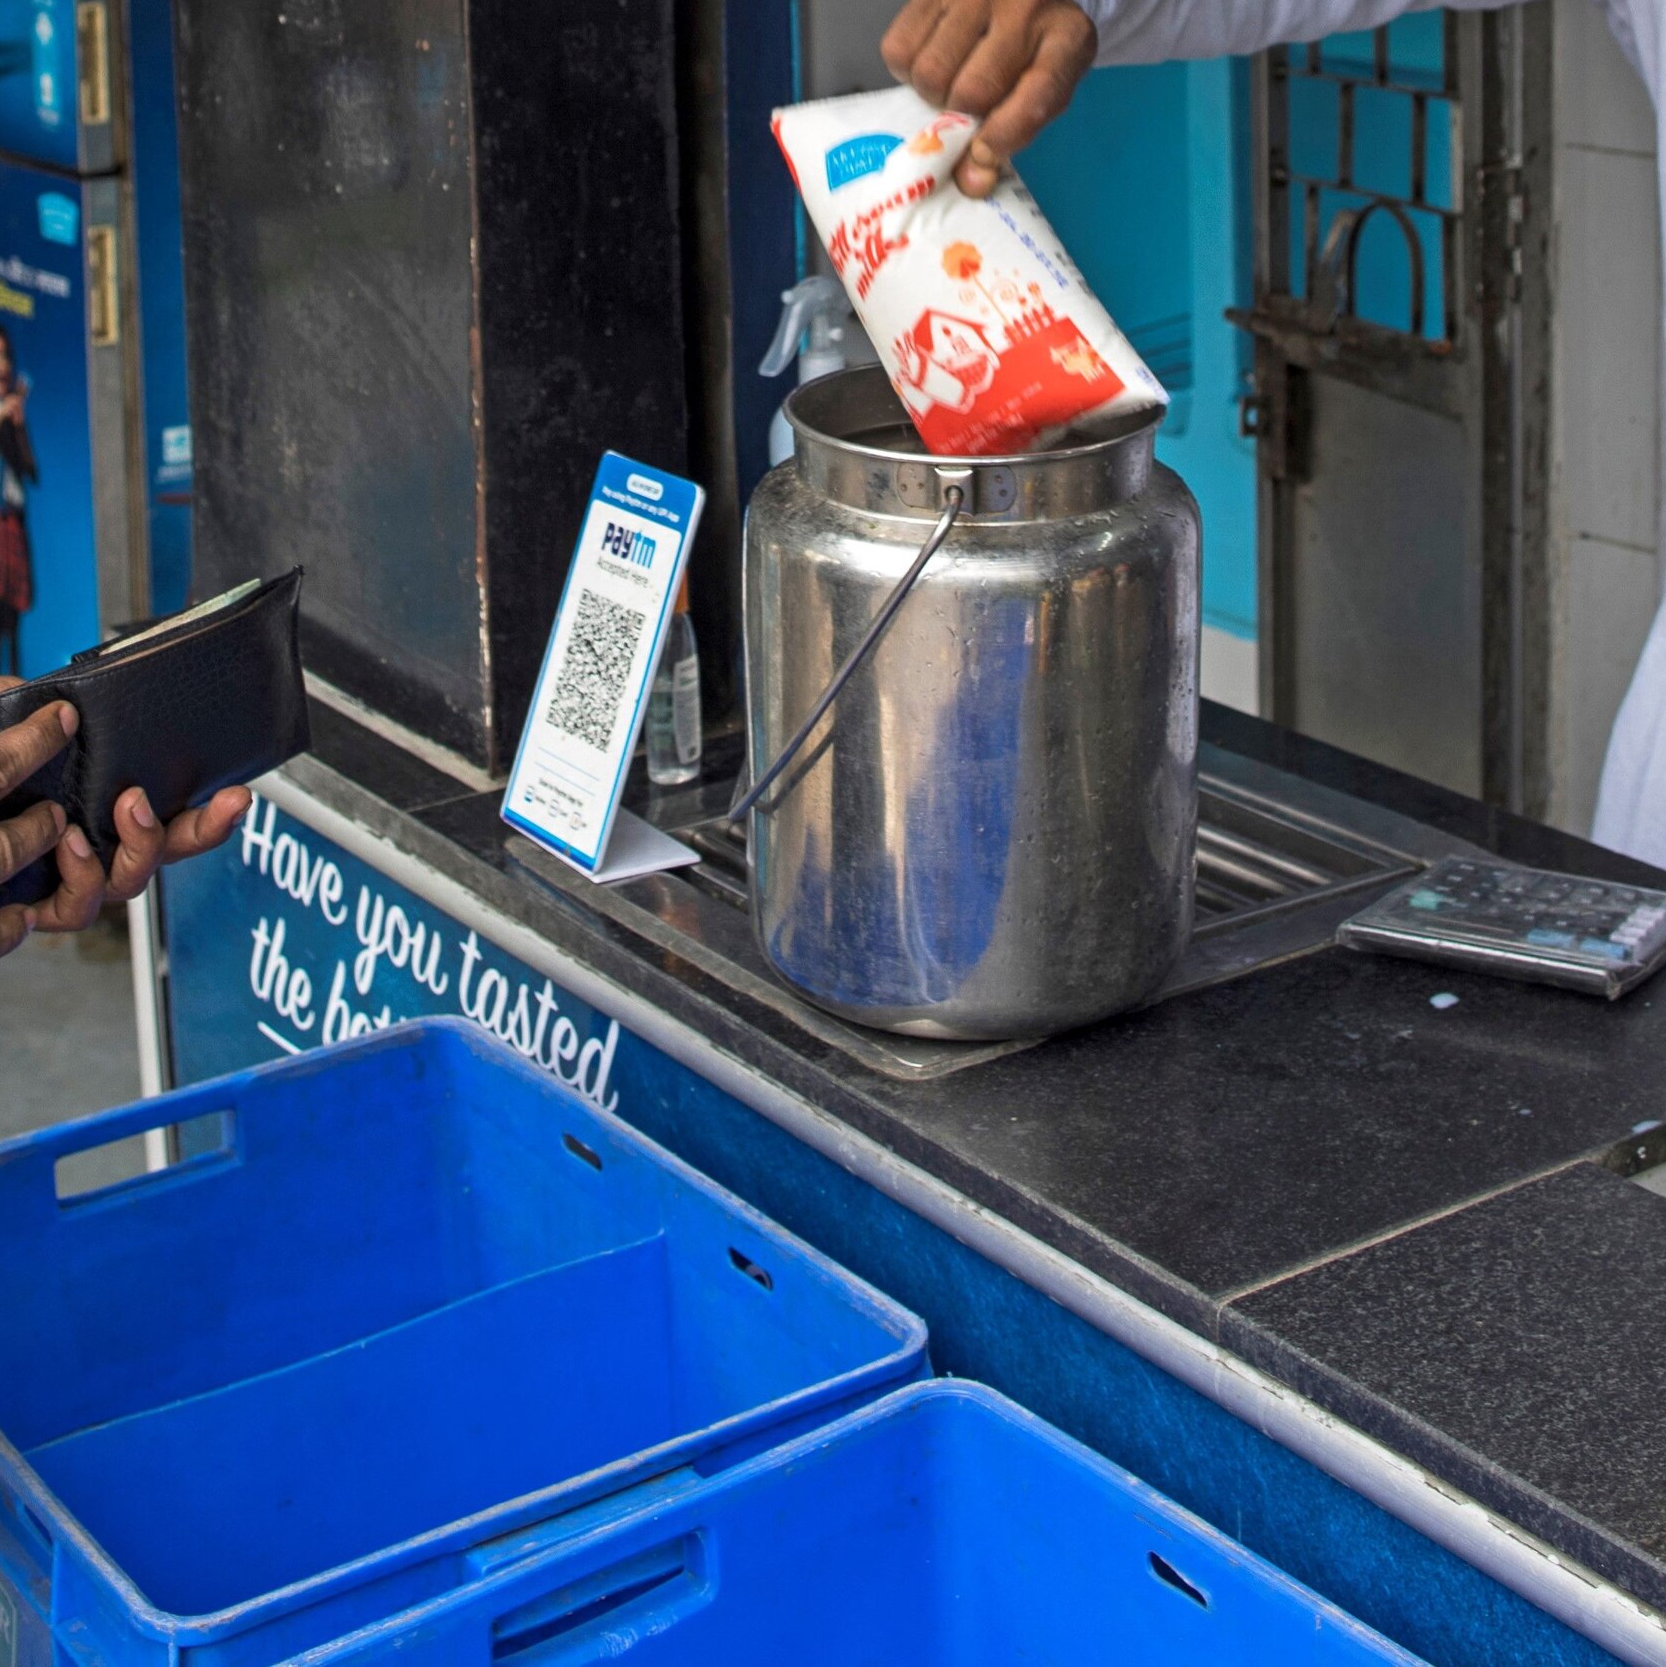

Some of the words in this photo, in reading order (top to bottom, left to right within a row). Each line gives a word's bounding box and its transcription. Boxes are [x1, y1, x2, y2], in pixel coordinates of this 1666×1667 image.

[242, 790, 348, 926] Have
[354, 884, 448, 996] you
[459, 929, 619, 1112] tasted
[250, 916, 315, 1031] the
